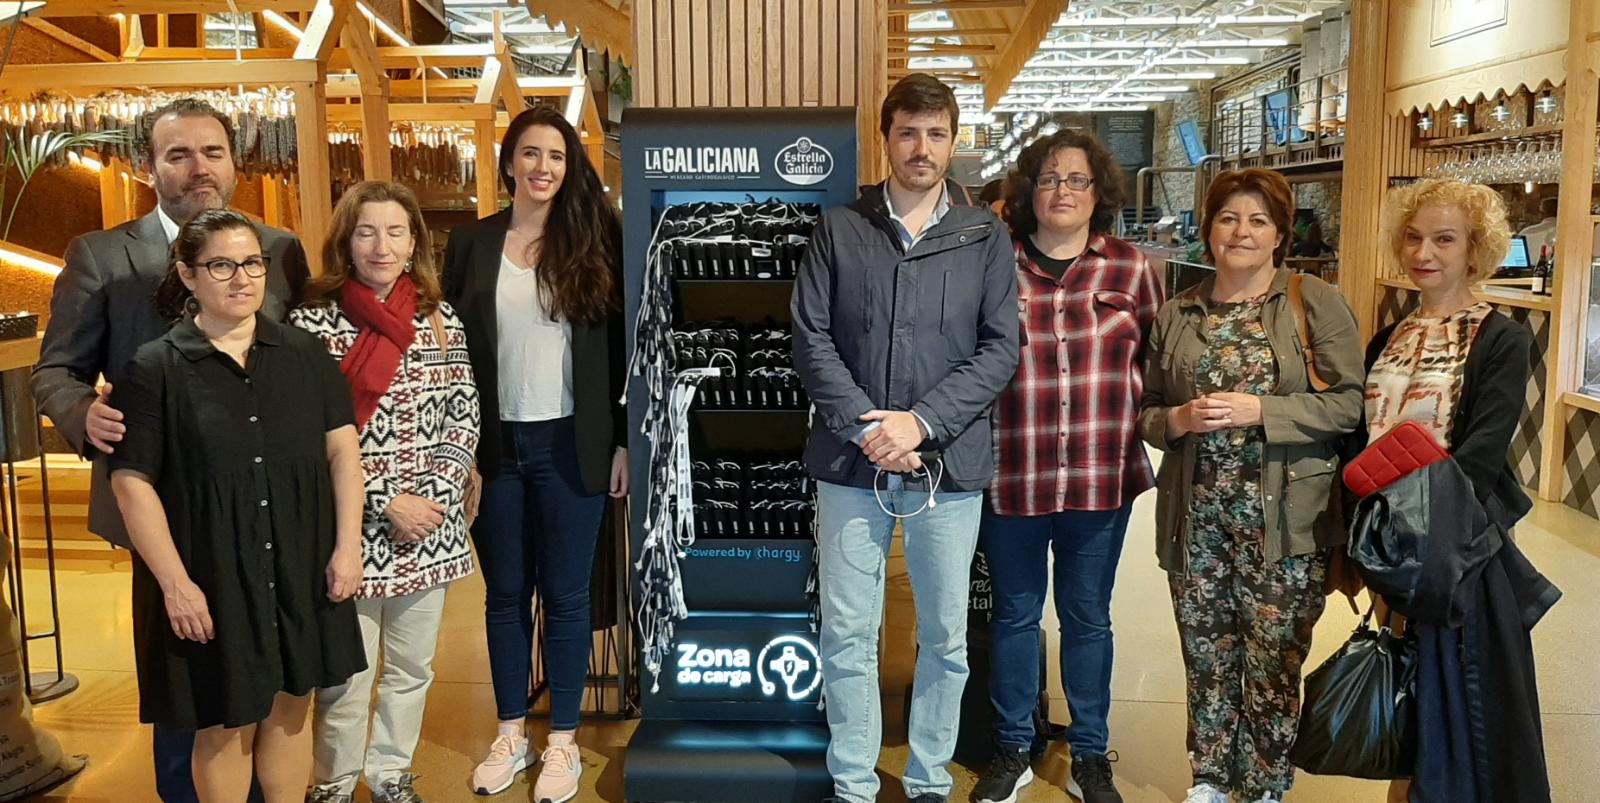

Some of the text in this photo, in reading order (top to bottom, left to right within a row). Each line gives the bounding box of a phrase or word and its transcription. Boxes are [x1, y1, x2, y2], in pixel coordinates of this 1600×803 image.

[645, 147, 760, 173] LA GALICIANA
[783, 151, 826, 163] Estrella
[785, 163, 824, 174] Galicia
[684, 548, 736, 558] Powered
[737, 548, 751, 560] by
[677, 643, 750, 668] Zona
[677, 667, 751, 687] de carga
